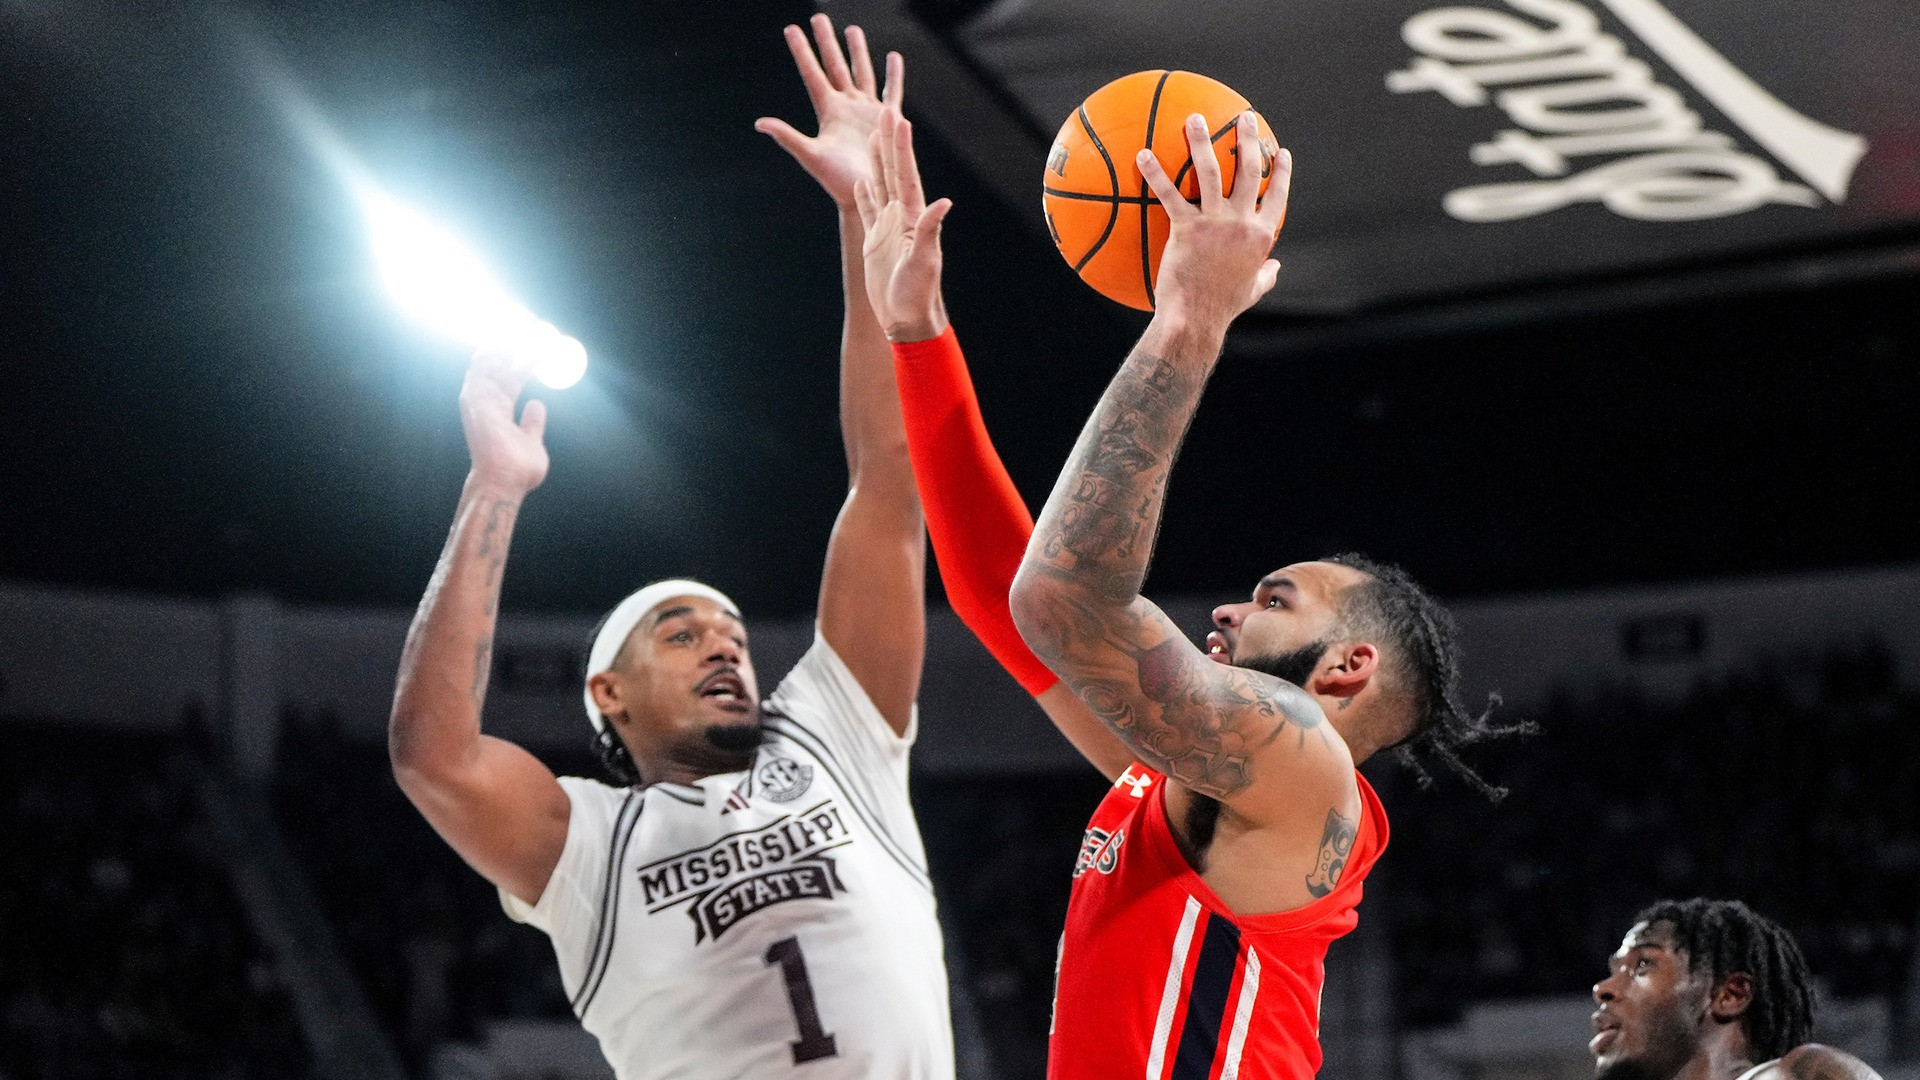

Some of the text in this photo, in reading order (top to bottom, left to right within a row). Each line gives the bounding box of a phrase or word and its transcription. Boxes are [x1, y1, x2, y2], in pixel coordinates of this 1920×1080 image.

[1385, 0, 1815, 222] State
[761, 759, 800, 792] SEC
[713, 869, 821, 926] STATE
[763, 935, 838, 1066] 1
